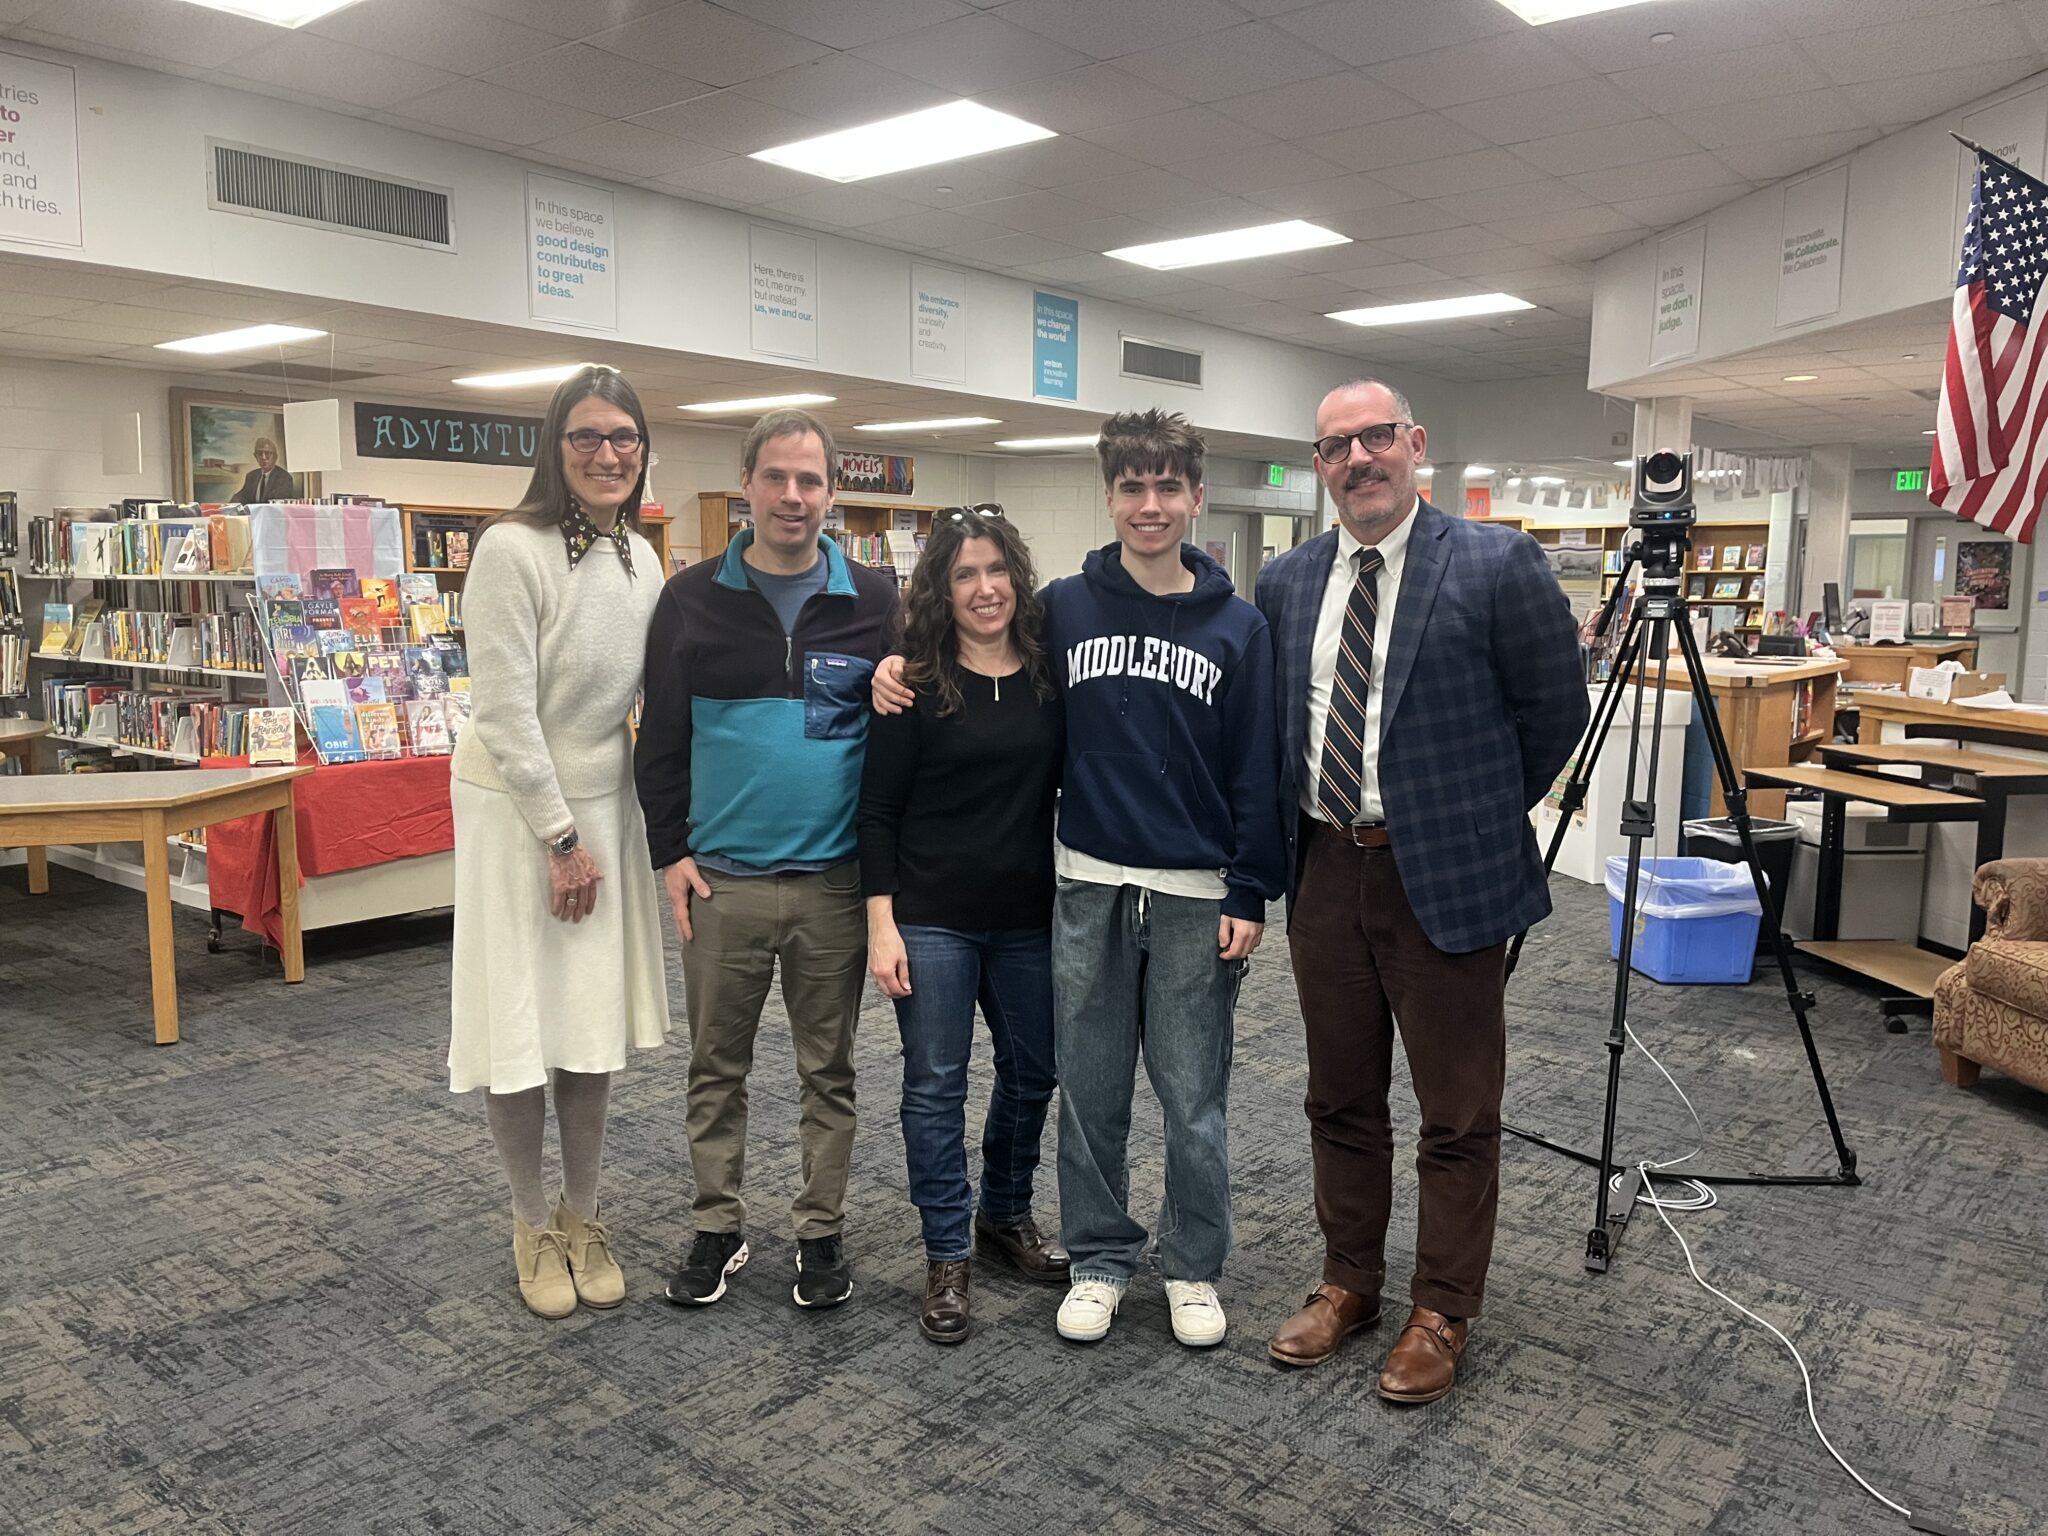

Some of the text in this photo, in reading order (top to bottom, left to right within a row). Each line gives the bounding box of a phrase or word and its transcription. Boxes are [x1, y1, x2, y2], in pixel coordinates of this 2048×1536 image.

[0, 105, 20, 123] to
[2, 173, 37, 190] and
[18, 194, 62, 215] tries.
[535, 197, 603, 224] In this space
[535, 217, 594, 238] we believe
[536, 234, 609, 258] good design
[537, 251, 606, 272] contributes
[538, 265, 584, 285] to great
[754, 263, 804, 283] Here, there is
[1662, 265, 1684, 282] In this
[538, 281, 574, 299] ideas.
[754, 277, 765, 287] no
[771, 282, 783, 291] me
[784, 285, 793, 293] or
[754, 290, 797, 306] but instead
[919, 291, 960, 308] We embrace
[1660, 294, 1693, 314] we don't
[754, 304, 814, 322] us, we and our.
[919, 328, 931, 337] and
[1037, 318, 1071, 332] we change
[1037, 328, 1048, 339] the
[1658, 316, 1683, 335] judge.
[842, 457, 880, 474] NOVELS
[1896, 471, 1923, 491] EXIT
[368, 656, 401, 669] PET
[1067, 635, 1223, 707] MIDDLEBURY
[324, 740, 349, 749] OBIE
